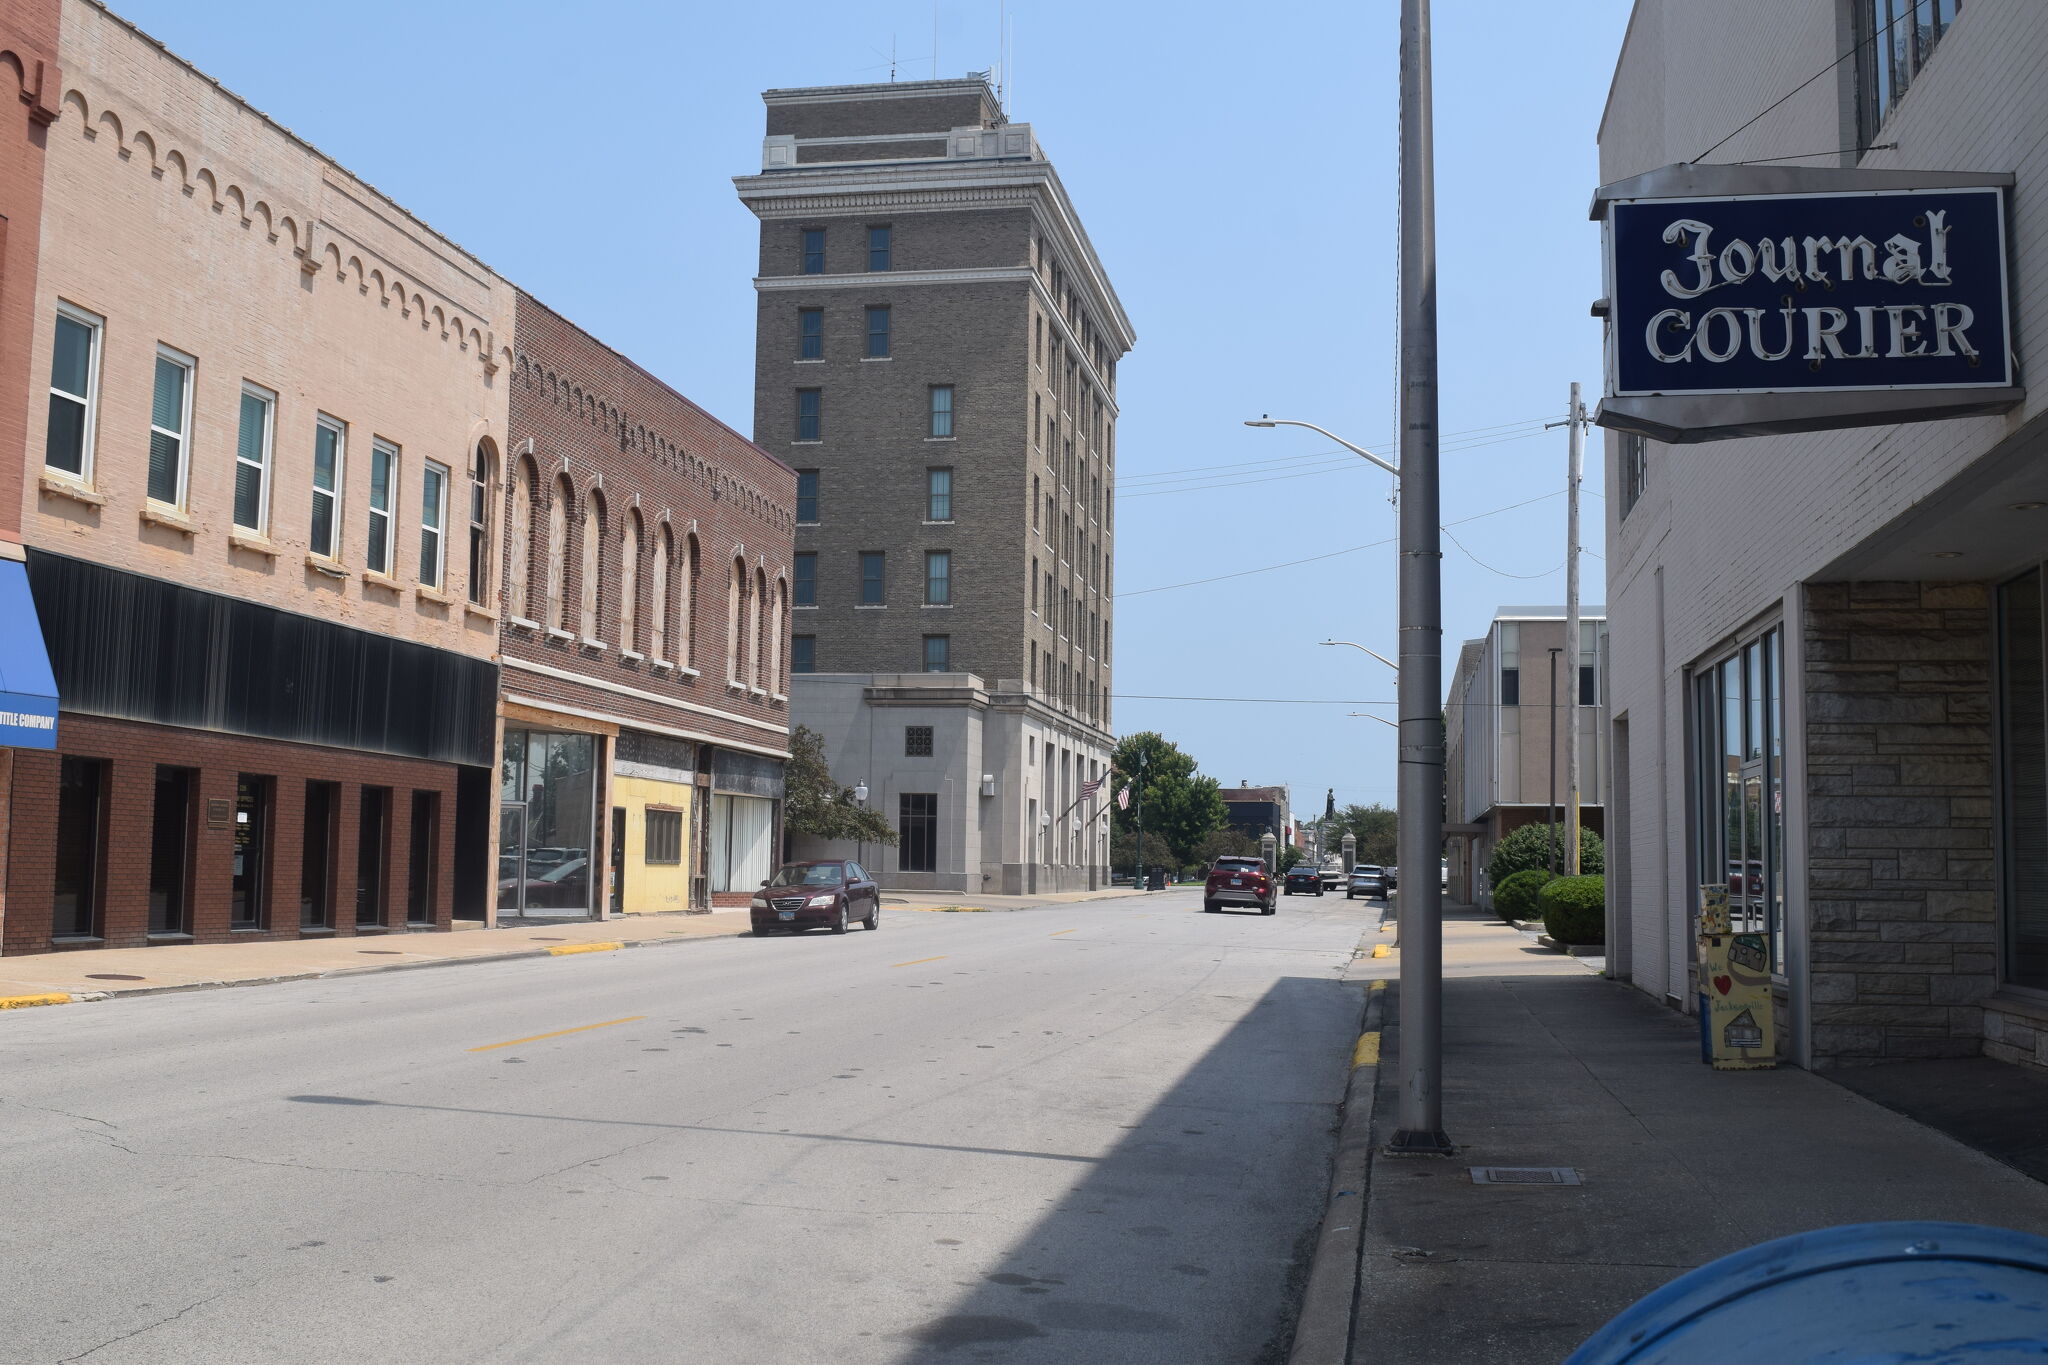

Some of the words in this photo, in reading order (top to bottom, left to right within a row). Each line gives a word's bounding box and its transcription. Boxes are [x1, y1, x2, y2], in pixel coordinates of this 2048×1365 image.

[1660, 209, 1952, 299] Journal
[1645, 303, 1980, 363] COURIER
[19, 713, 55, 730] COMPANY
